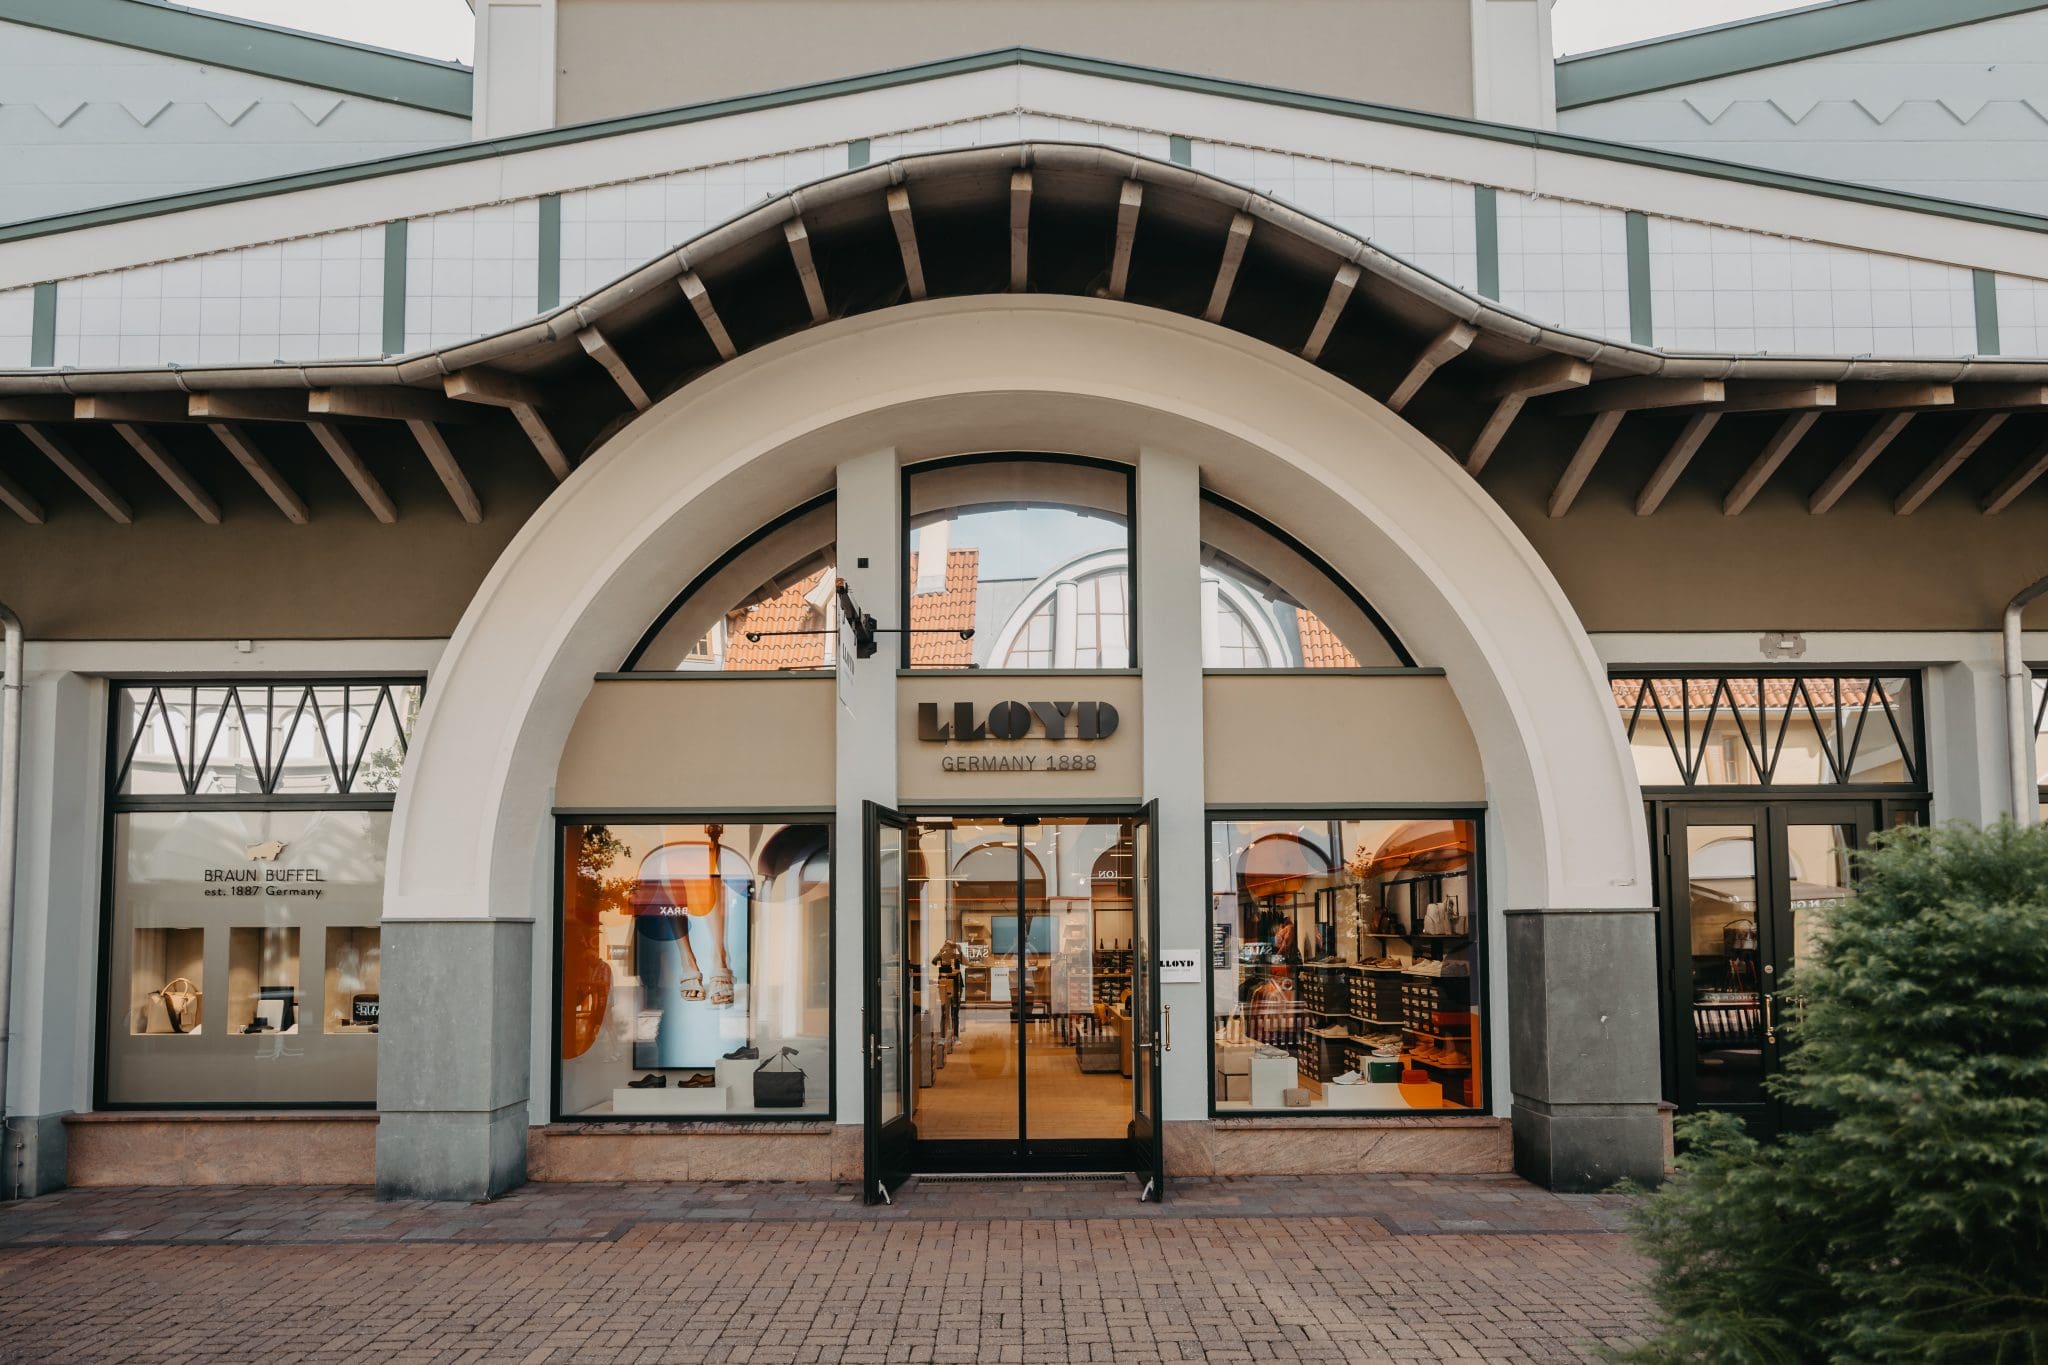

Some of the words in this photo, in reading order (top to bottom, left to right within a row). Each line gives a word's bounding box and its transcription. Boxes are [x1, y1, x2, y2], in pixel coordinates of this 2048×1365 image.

[918, 700, 1119, 741] LLOYD
[941, 755, 1036, 771] GERMANY
[1046, 754, 1097, 771] 1888
[204, 869, 257, 882] BRAUN
[265, 868, 326, 882] BÜFFEL
[204, 887, 227, 897] est.
[231, 885, 260, 897] 1887
[265, 885, 322, 900] Germany
[1159, 960, 1194, 968] LLOYD
